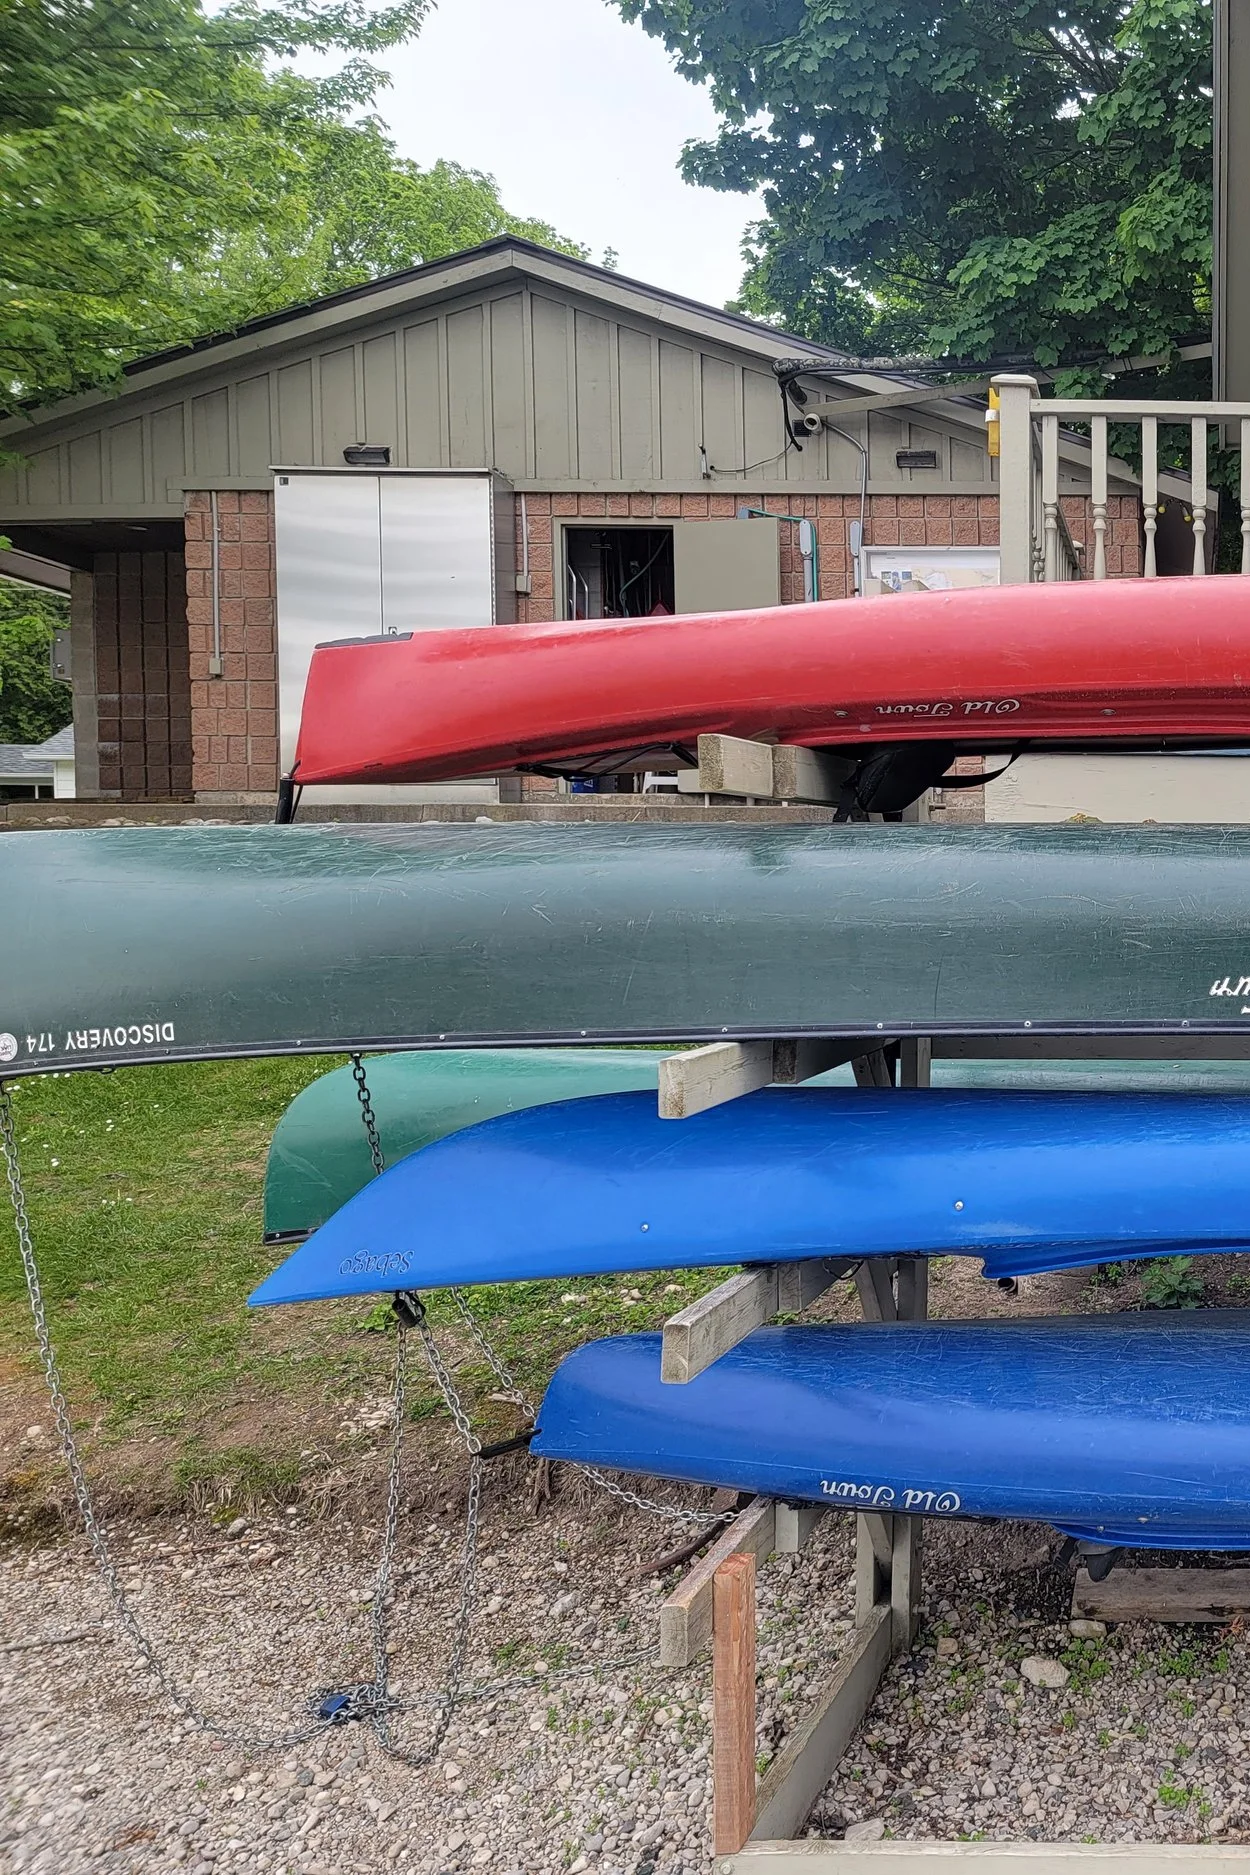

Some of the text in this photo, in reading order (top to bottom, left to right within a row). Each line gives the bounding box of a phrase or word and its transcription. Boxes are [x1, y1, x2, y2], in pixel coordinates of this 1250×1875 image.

[875, 699, 1020, 718] Old Town
[26, 1032, 56, 1054] 174
[65, 1022, 175, 1050] DISCOVERY
[339, 1249, 415, 1278] Sebago
[819, 1480, 961, 1512] Old Town
